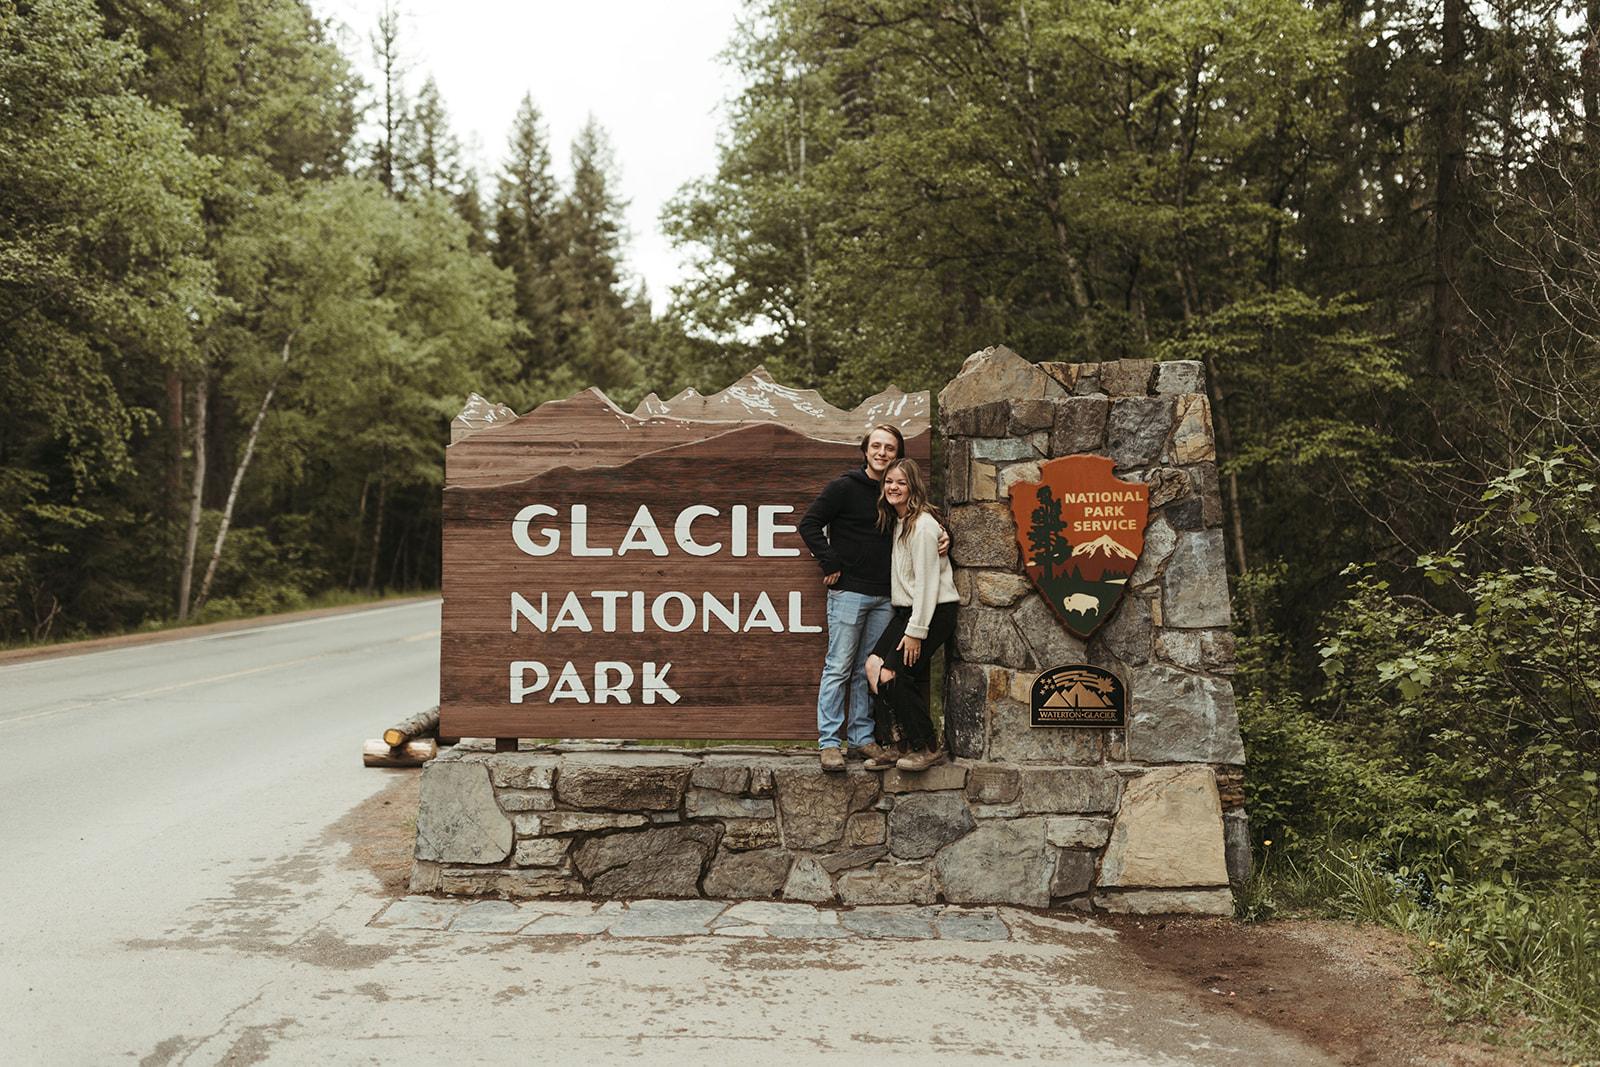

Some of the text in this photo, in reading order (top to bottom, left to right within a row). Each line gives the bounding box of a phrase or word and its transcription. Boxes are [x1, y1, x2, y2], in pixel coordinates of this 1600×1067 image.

[1065, 491, 1143, 504] NATIONAL
[1084, 506, 1125, 517] PARK
[511, 504, 830, 556] GLACIE
[1073, 519, 1137, 532] SERVICE
[511, 591, 823, 633] NATIONAL
[510, 661, 681, 704] PARK
